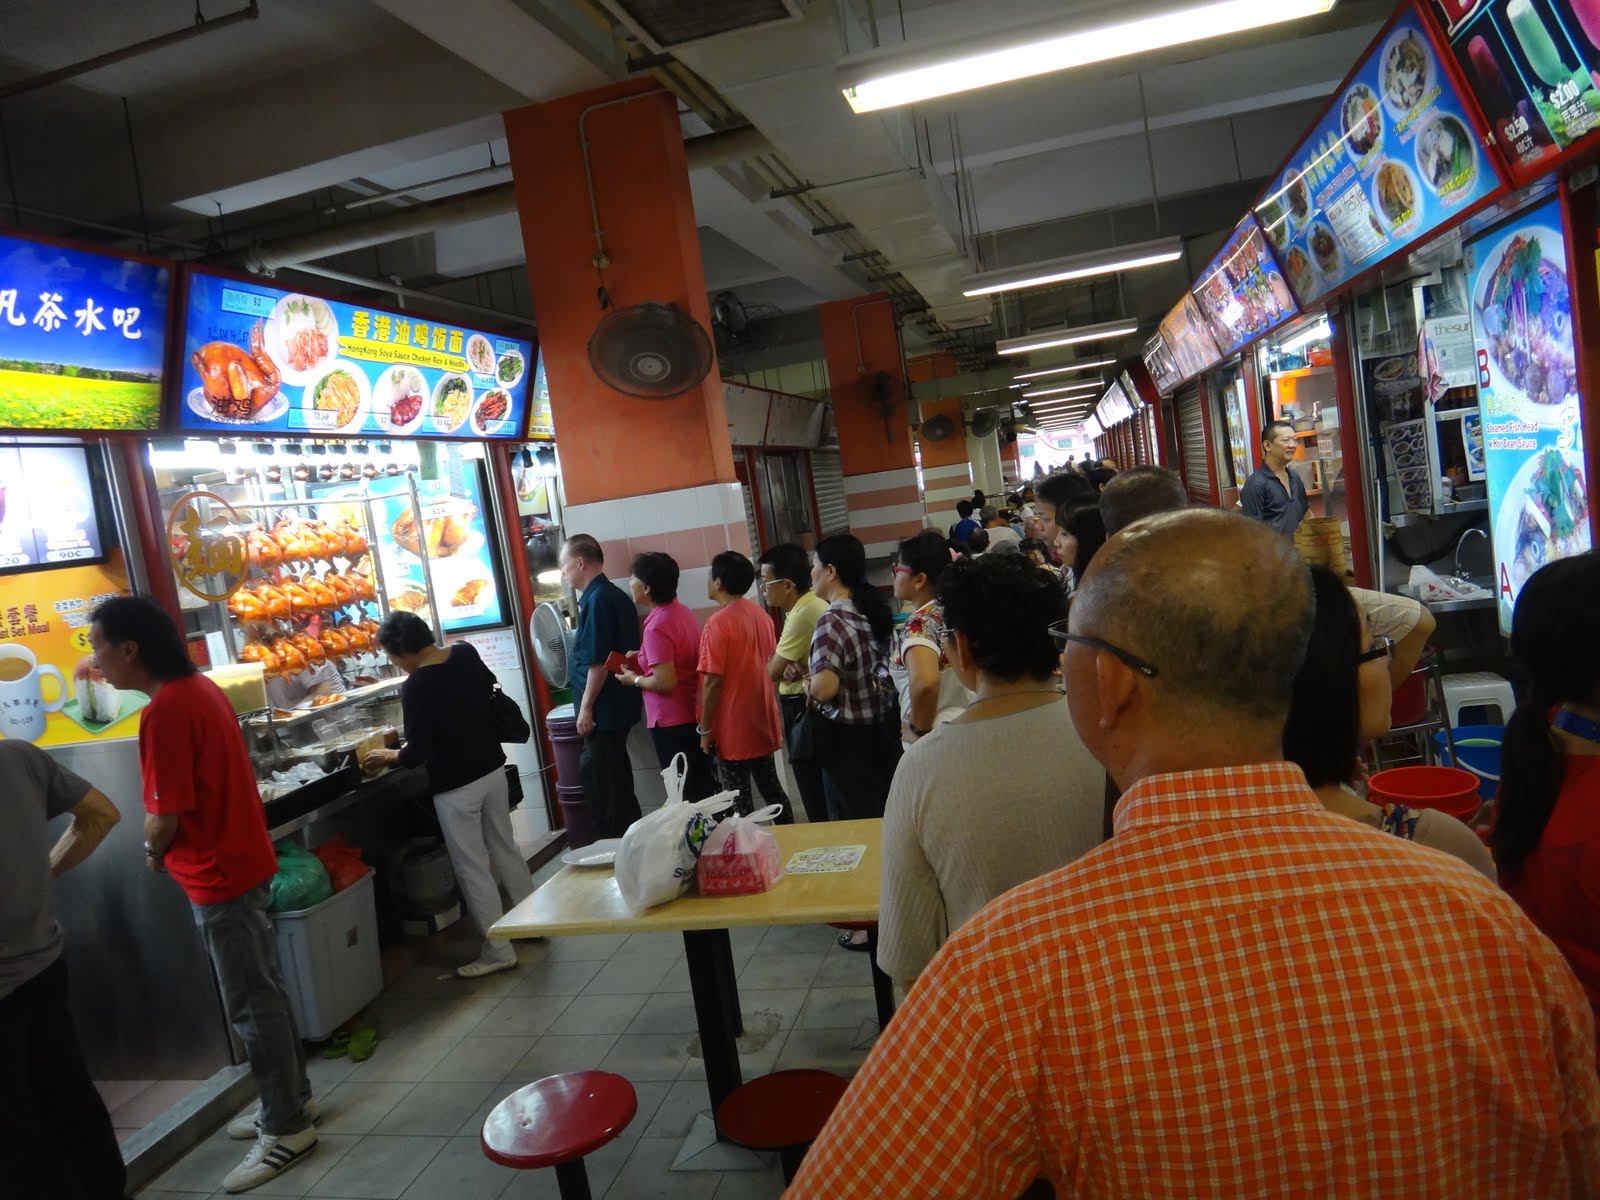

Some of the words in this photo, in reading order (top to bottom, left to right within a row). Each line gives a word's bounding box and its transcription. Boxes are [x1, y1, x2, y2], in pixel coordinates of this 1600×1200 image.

[1549, 79, 1580, 110] $2.00
[1504, 115, 1529, 142] $2.50
[352, 310, 465, 354] 香港油鸡饭面
[347, 343, 378, 358] HongKong
[379, 348, 393, 358] Soya
[393, 350, 411, 360] Sauce
[411, 352, 431, 363] Chicken
[432, 355, 443, 365] Rice
[449, 358, 465, 368] Noodle
[1477, 349, 1490, 389] B
[210, 394, 251, 416] 油鸡
[1487, 423, 1509, 433] Steamed
[1510, 422, 1521, 432] Fish
[1522, 421, 1538, 431] Head
[1504, 438, 1518, 448] Bean
[1519, 438, 1536, 448] Sauce
[1500, 562, 1514, 601] A
[10, 626, 26, 638] Set
[27, 621, 50, 635] Meal
